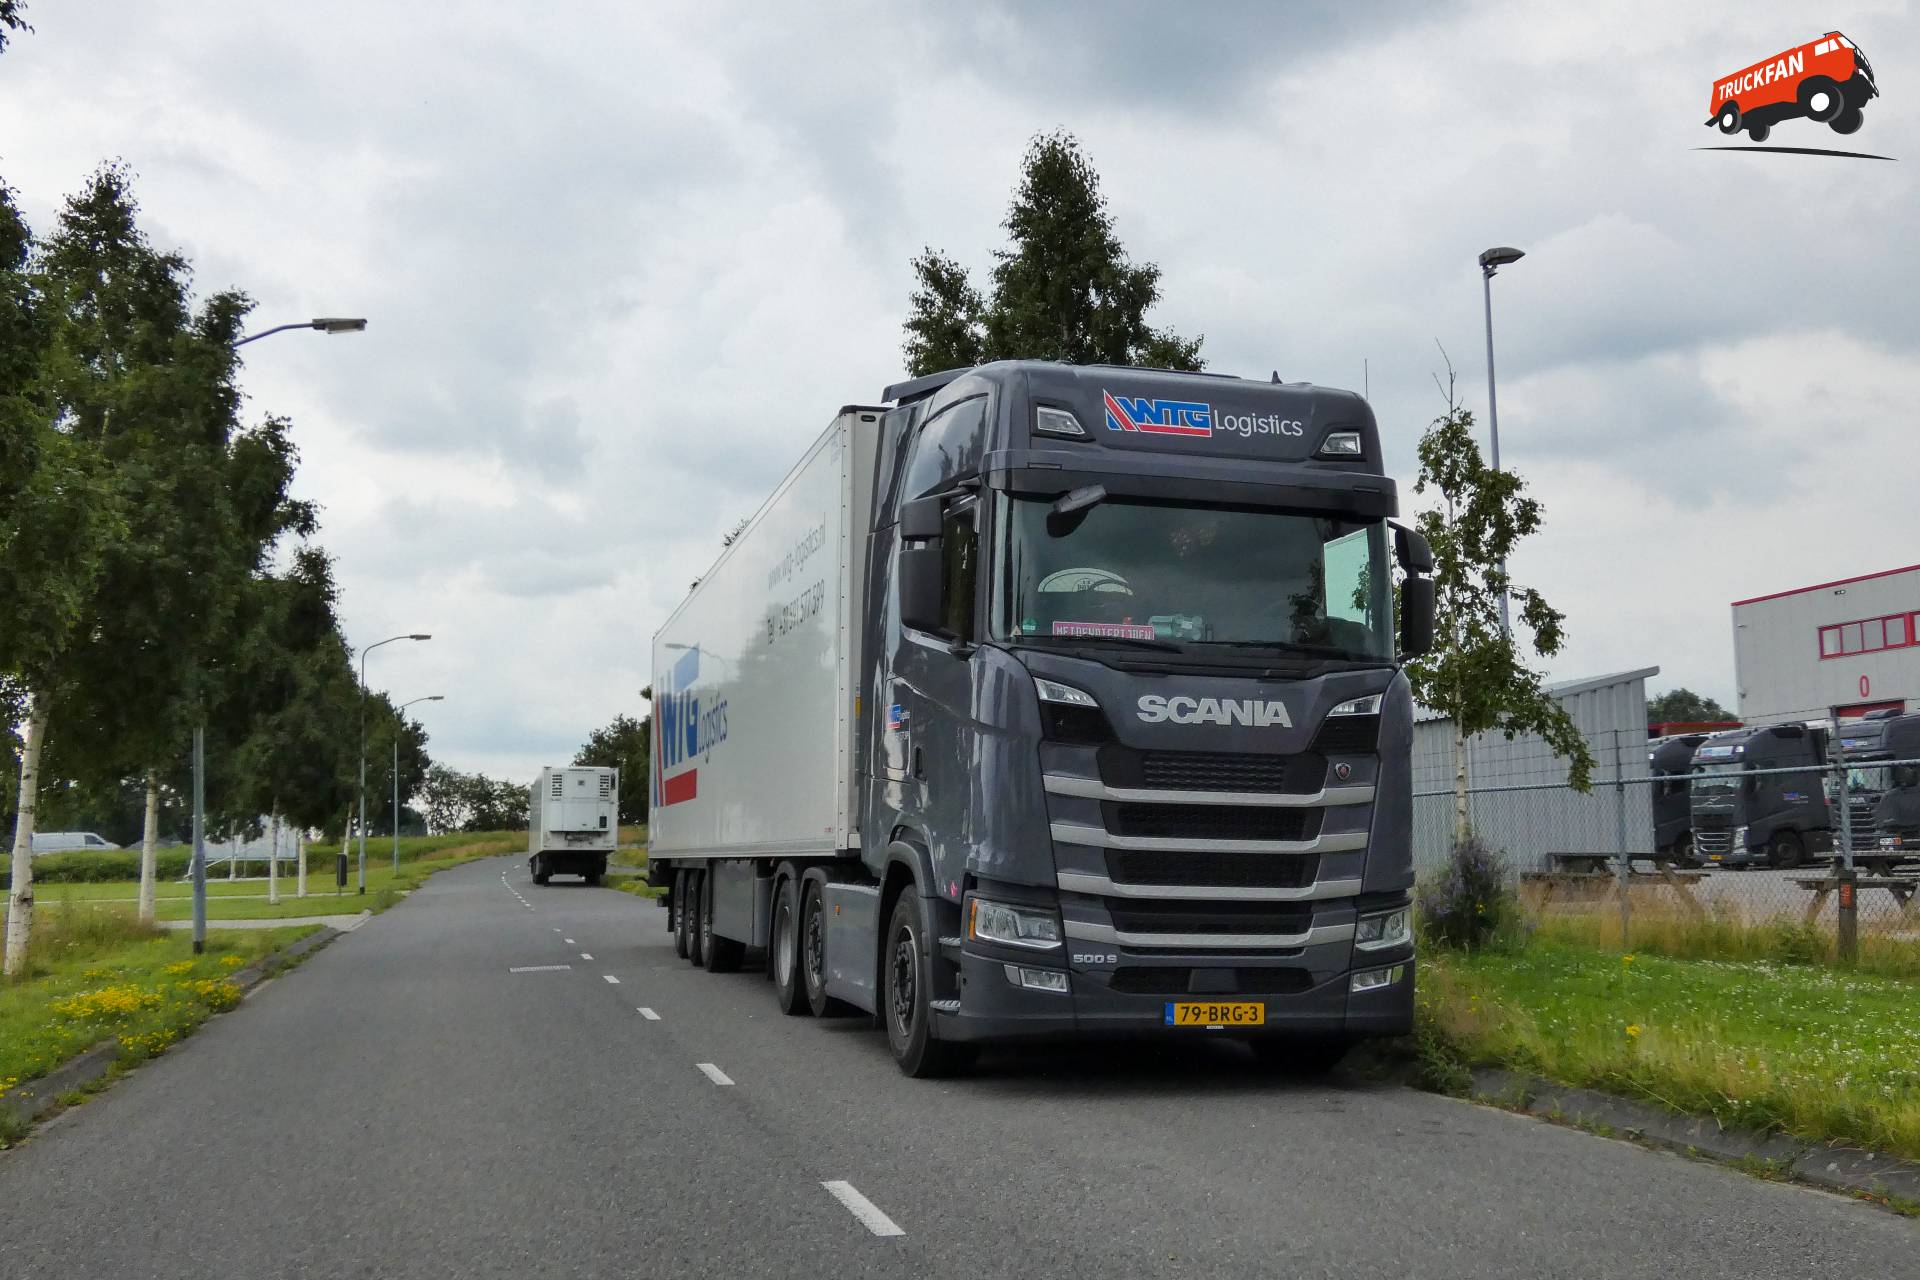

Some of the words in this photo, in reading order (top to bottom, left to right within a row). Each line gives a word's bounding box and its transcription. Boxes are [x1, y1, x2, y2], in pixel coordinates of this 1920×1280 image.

[1114, 396, 1211, 429] WTG
[1214, 409, 1303, 437] Logistics
[698, 688, 728, 764] Logistics
[1136, 695, 1293, 728] SCANIA
[1073, 954, 1105, 964] 500
[1106, 954, 1118, 964] S
[1180, 1006, 1258, 1022] 79-BRG-3
